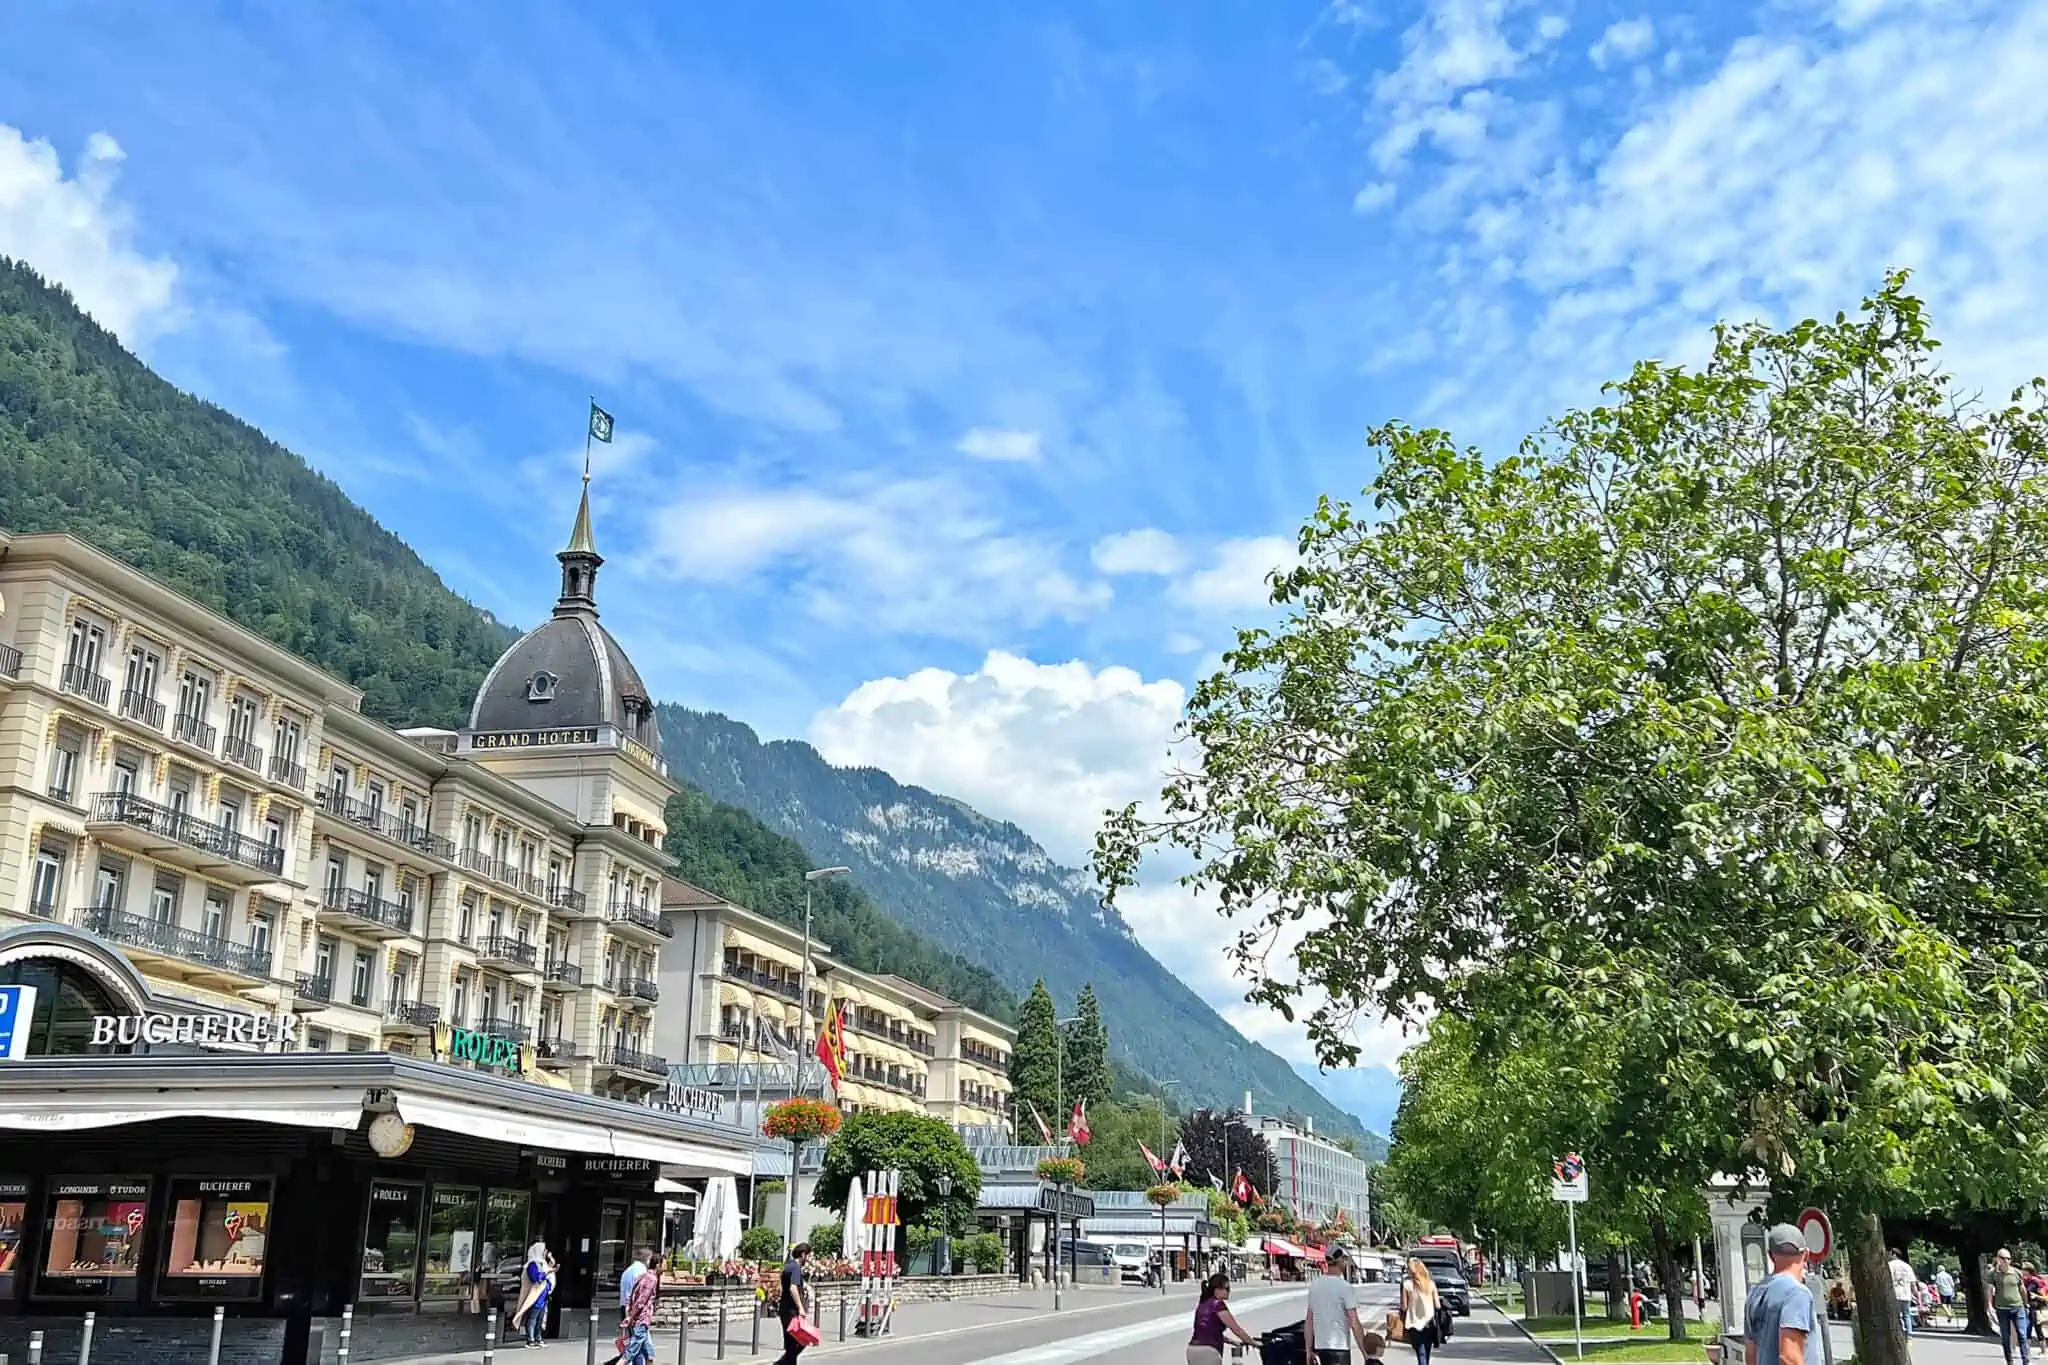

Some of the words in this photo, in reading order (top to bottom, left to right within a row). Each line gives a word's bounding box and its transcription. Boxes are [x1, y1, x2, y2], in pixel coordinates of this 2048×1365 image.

[476, 734, 530, 748] GRAND
[537, 730, 592, 745] HOTEL
[90, 1012, 300, 1045] BUCHERER
[454, 1029, 518, 1071] ROLEX
[668, 1082, 725, 1116] BUCHERER
[584, 1159, 651, 1172] BUCHERER
[117, 1185, 146, 1194] TUDOR
[199, 1181, 252, 1192] BUCHERER
[379, 1189, 402, 1201] ROLEX
